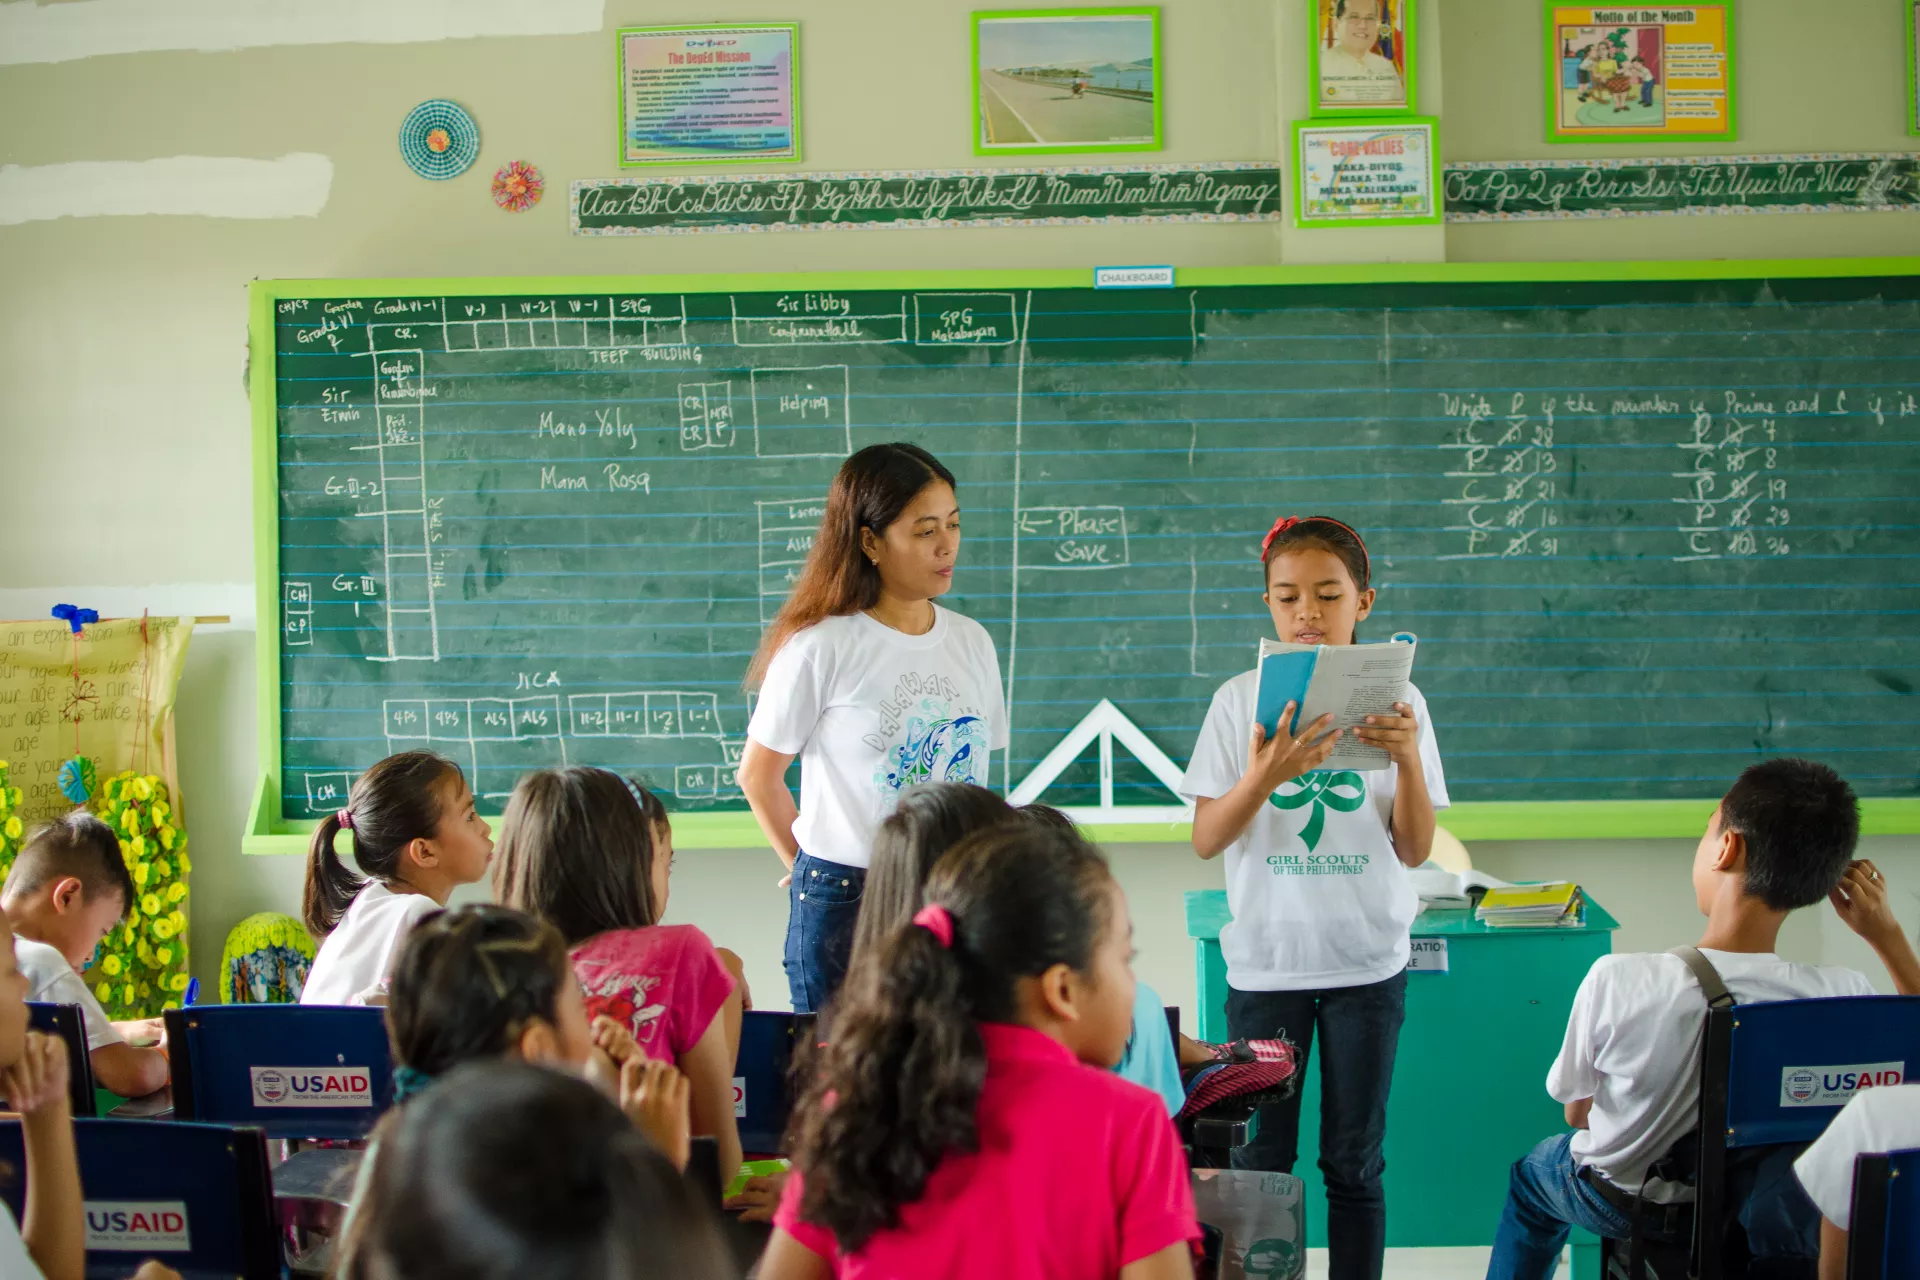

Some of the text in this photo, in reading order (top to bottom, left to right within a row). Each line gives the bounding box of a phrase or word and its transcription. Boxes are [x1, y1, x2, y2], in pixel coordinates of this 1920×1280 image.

[1594, 10, 1694, 22] Motto of the Month
[668, 51, 750, 64] The DepEd Mission
[1363, 140, 1405, 155] VALUES
[1101, 272, 1168, 282] CHALKBOARD
[324, 299, 363, 314] Garden
[374, 301, 408, 315] Grade
[621, 298, 652, 314] SPG
[776, 292, 850, 317] Sir Libby
[940, 307, 973, 328] SPG
[297, 316, 339, 344] Grade
[931, 324, 998, 343] Makabayan
[640, 346, 702, 365] BUILDING
[322, 387, 350, 403] Sir
[684, 396, 703, 410] CR
[1438, 392, 1495, 416] Write
[1564, 393, 1599, 413] the
[1611, 394, 1680, 416] number
[1724, 390, 1776, 415] Prime
[1785, 392, 1820, 415] and
[779, 394, 829, 419] Helping
[595, 407, 638, 450] Yoly
[682, 425, 703, 441] CR
[1536, 451, 1557, 474] 13
[1765, 448, 1777, 469] 8
[539, 465, 590, 492] Mana
[1538, 480, 1555, 502] 21
[1769, 479, 1788, 500] 19
[1468, 504, 1558, 528] C 16
[1467, 530, 1558, 556] P 31
[1690, 532, 1712, 553] C
[290, 588, 309, 602] CH
[33, 627, 113, 652] expresion
[30, 666, 57, 687] age
[514, 670, 562, 690] JICA
[0, 681, 140, 711] our age nine
[0, 711, 17, 728] our
[25, 709, 51, 733] age
[521, 709, 548, 727] ALS
[14, 736, 39, 759] age
[317, 783, 337, 801] CH
[1266, 854, 1370, 865] GIRL SCOUTS
[1273, 864, 1363, 875] OF THE PHILIPPINES
[291, 1075, 368, 1093] USAID
[1823, 1070, 1901, 1091] USAID
[87, 1211, 184, 1233] USAID
